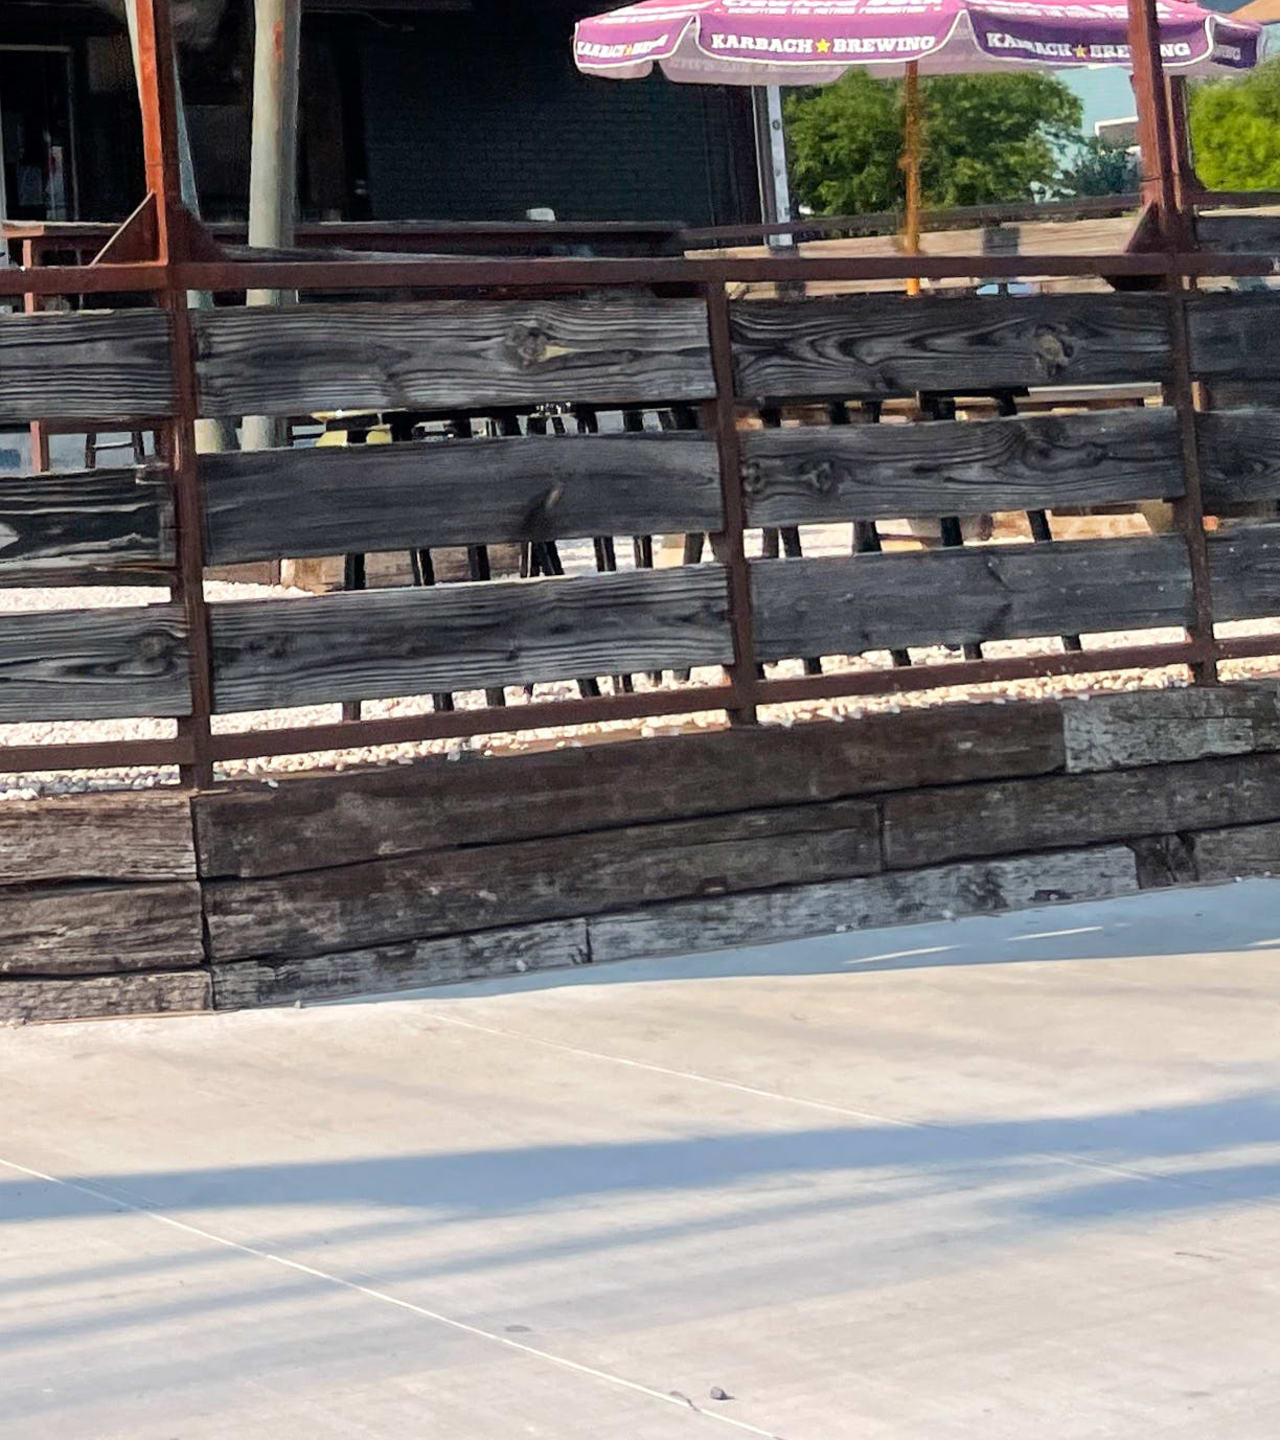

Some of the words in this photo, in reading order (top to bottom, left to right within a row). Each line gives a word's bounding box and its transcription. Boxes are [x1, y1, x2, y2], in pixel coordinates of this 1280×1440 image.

[711, 34, 814, 53] KARBACH
[832, 35, 936, 53] BREWING
[1090, 42, 1191, 58] BRENG
